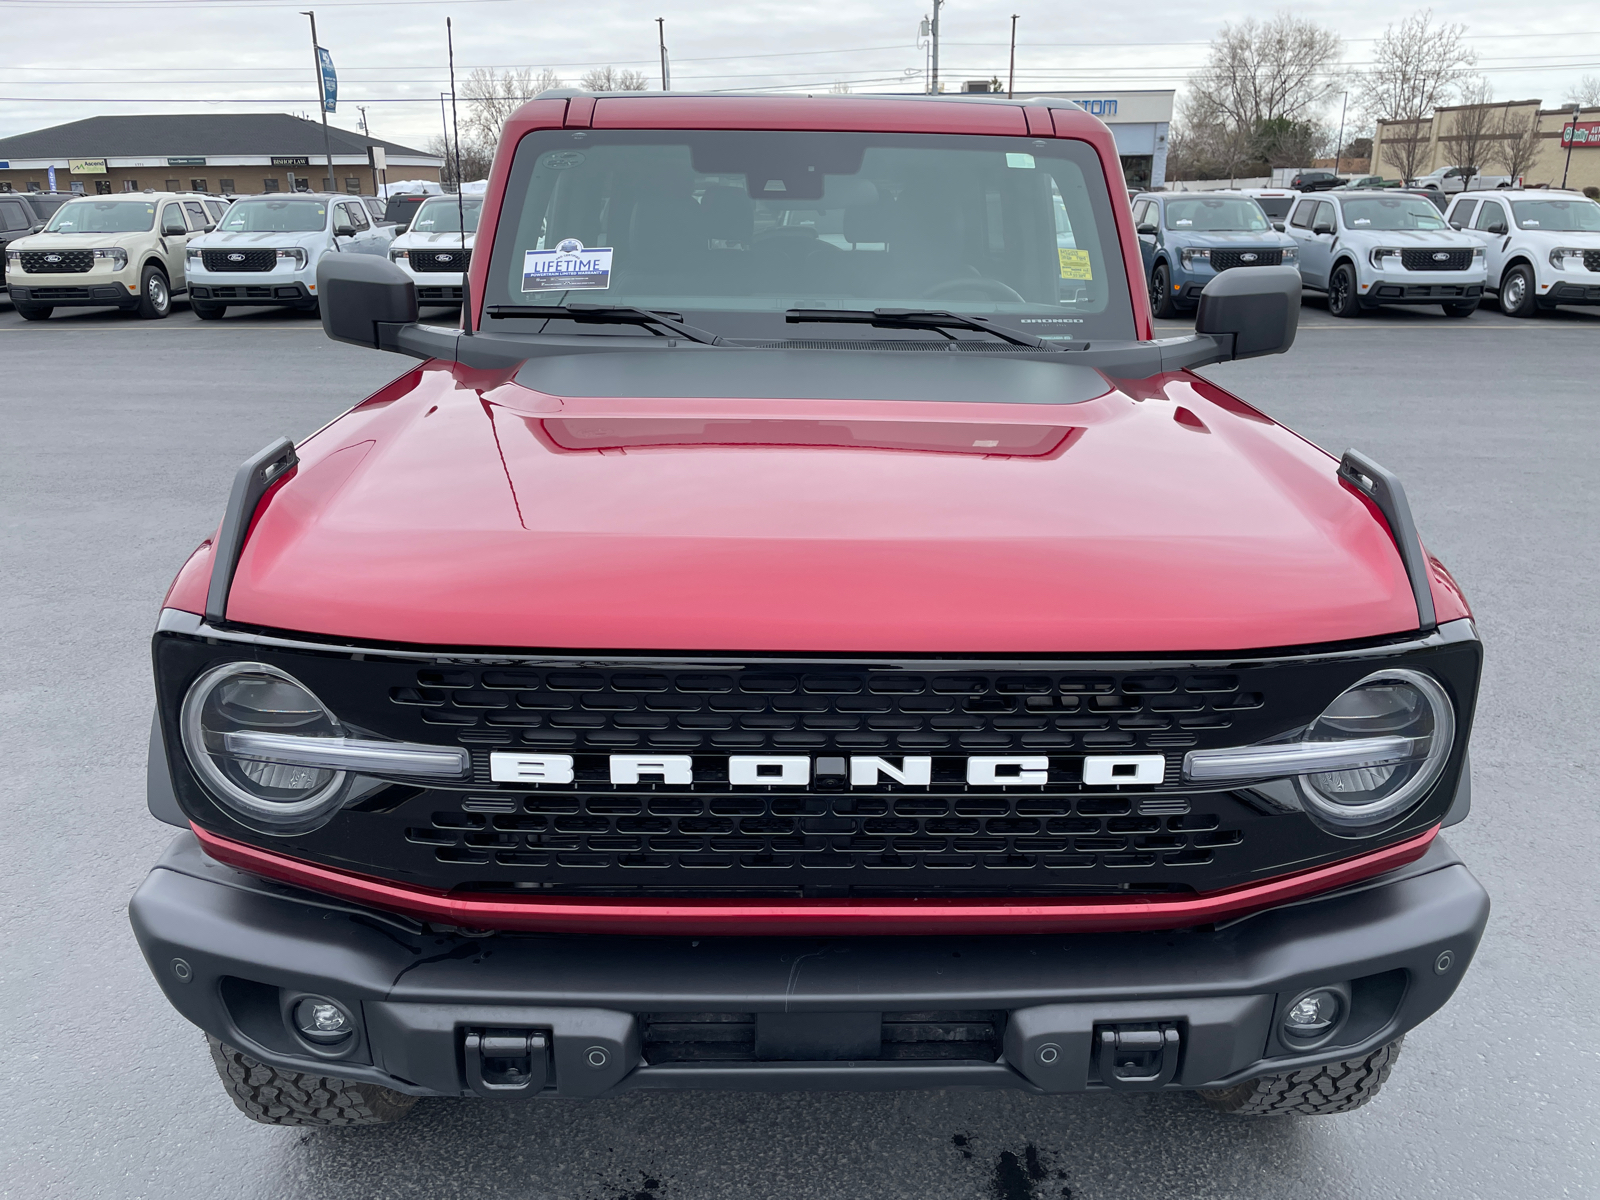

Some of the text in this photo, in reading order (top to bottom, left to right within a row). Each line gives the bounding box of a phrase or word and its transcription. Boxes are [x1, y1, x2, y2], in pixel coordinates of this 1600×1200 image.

[1073, 100, 1117, 115] TOM
[534, 259, 600, 273] LIFETIME
[490, 752, 1166, 786] BRONCO
